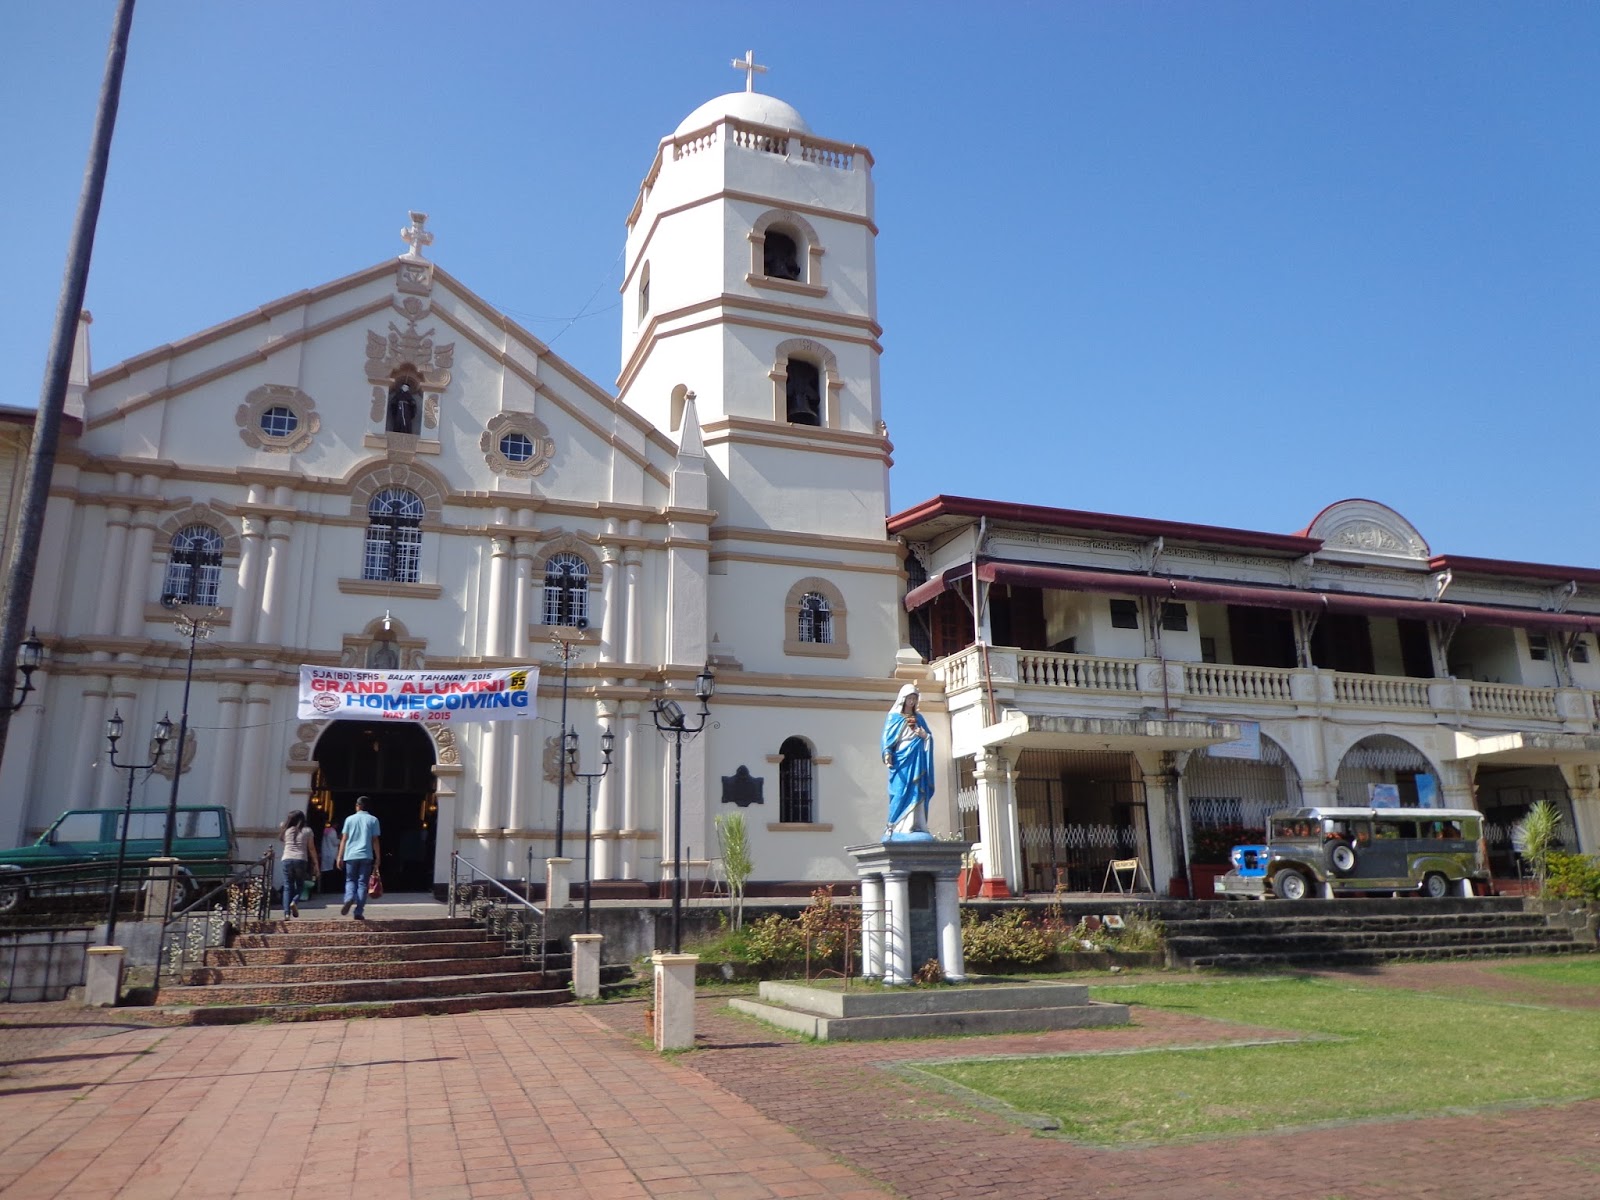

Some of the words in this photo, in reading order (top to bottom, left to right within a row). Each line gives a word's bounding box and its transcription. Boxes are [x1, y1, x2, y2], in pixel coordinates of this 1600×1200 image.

[387, 673, 415, 681] BALIK
[472, 673, 492, 681] 2015
[311, 678, 388, 694] GRAND
[400, 679, 506, 695] ALUMNI
[346, 690, 529, 711] HOMECOMING
[382, 711, 405, 720] MAY
[428, 711, 451, 720] 2015
